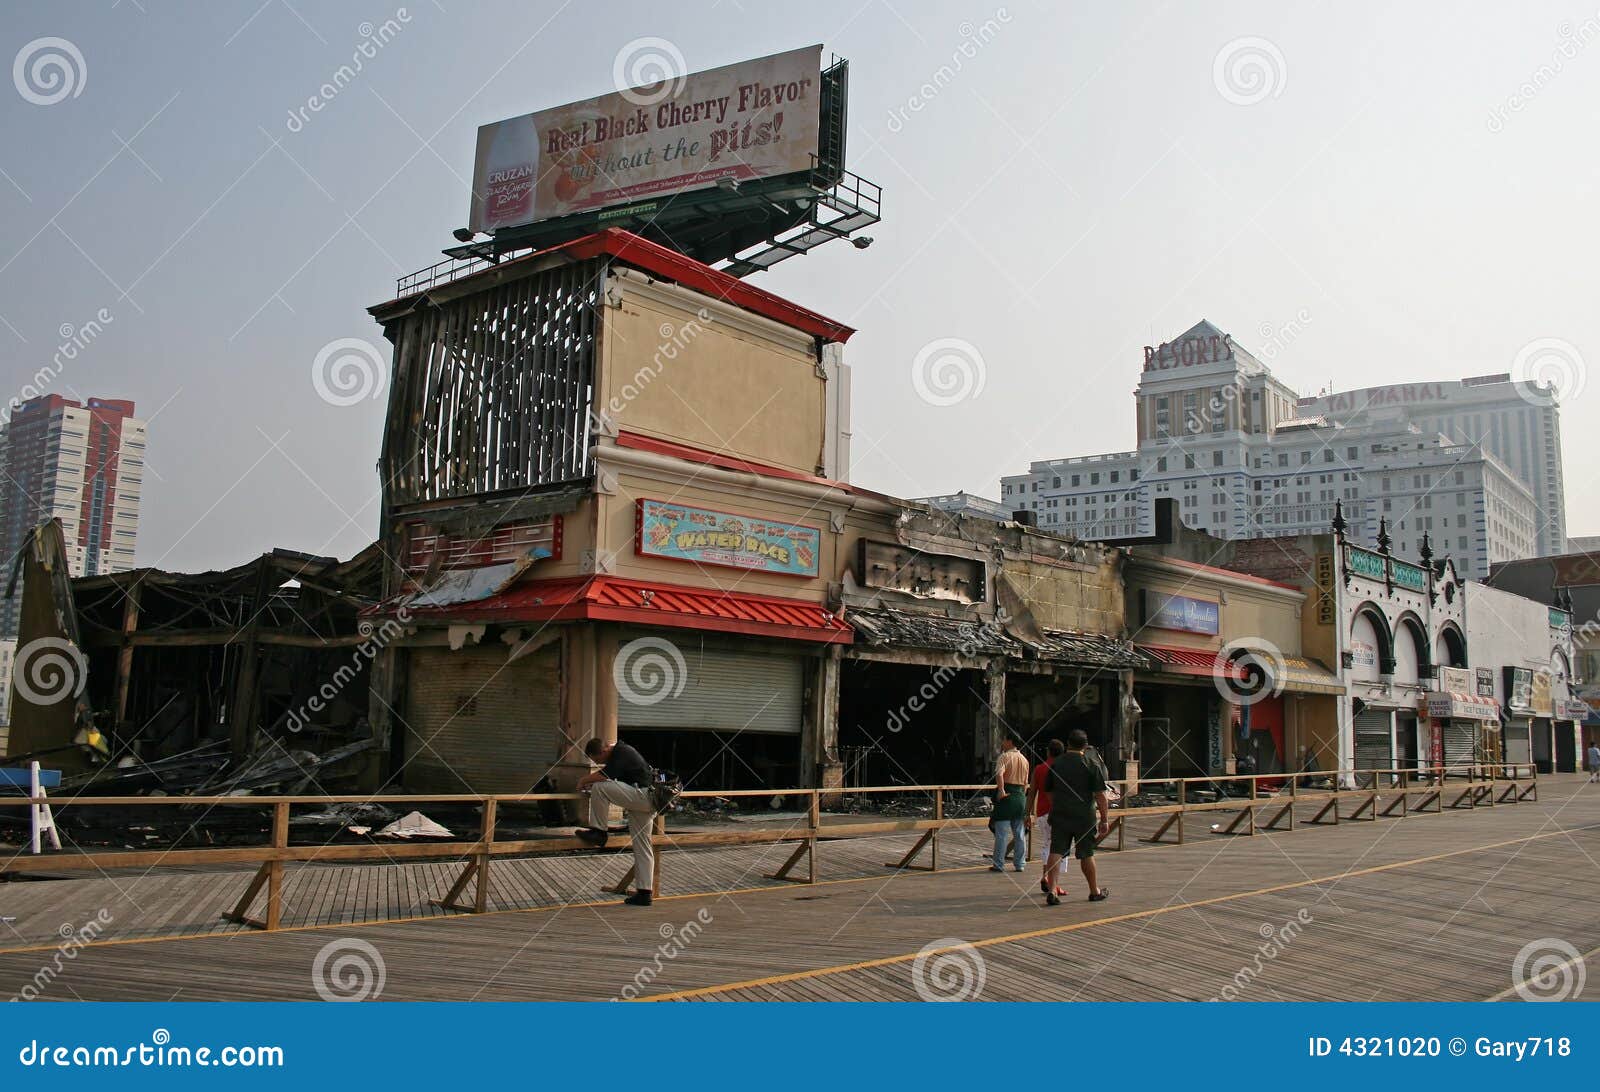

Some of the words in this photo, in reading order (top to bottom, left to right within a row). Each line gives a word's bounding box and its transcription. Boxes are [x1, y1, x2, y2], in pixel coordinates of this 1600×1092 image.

[546, 121, 588, 154] Real
[594, 109, 649, 143] Black
[656, 96, 730, 130] Cherry
[737, 79, 811, 112] Flavor
[571, 147, 654, 179] without
[663, 137, 699, 162] the
[709, 112, 783, 162] pits!
[488, 166, 533, 184] CRUZAN
[1143, 333, 1232, 372] RESORTS
[1325, 391, 1356, 413] TAJ
[1367, 383, 1449, 407] MAHAL
[676, 530, 742, 549] WATER
[745, 535, 789, 564] RACE
